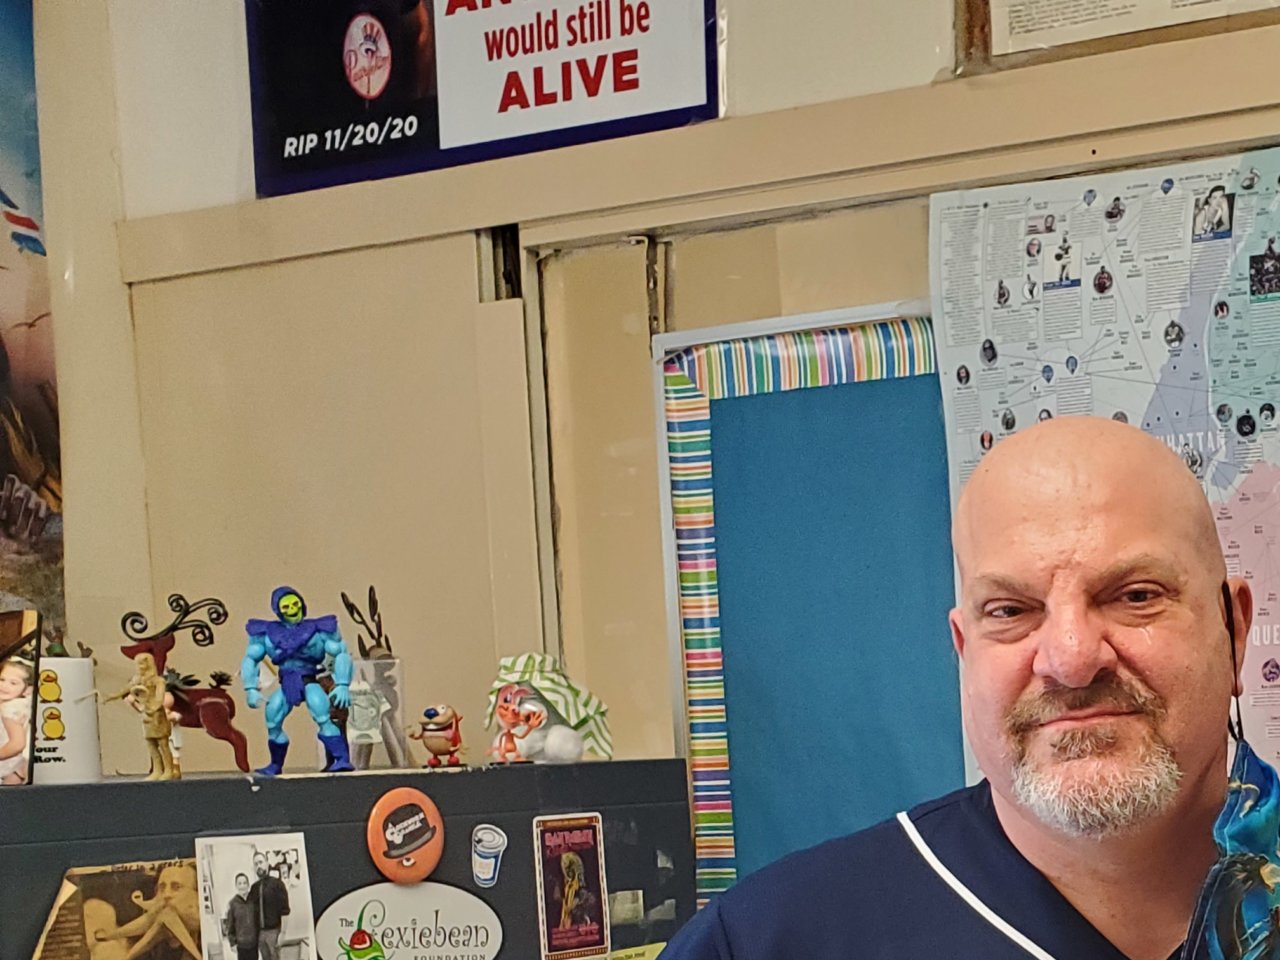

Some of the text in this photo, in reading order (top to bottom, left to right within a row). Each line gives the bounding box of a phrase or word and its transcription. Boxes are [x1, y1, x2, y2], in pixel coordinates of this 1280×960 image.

[484, 0, 650, 61] would still be
[498, 49, 640, 113] ALIVE
[284, 115, 418, 158] RIP 11/20/20
[339, 918, 354, 927] The
